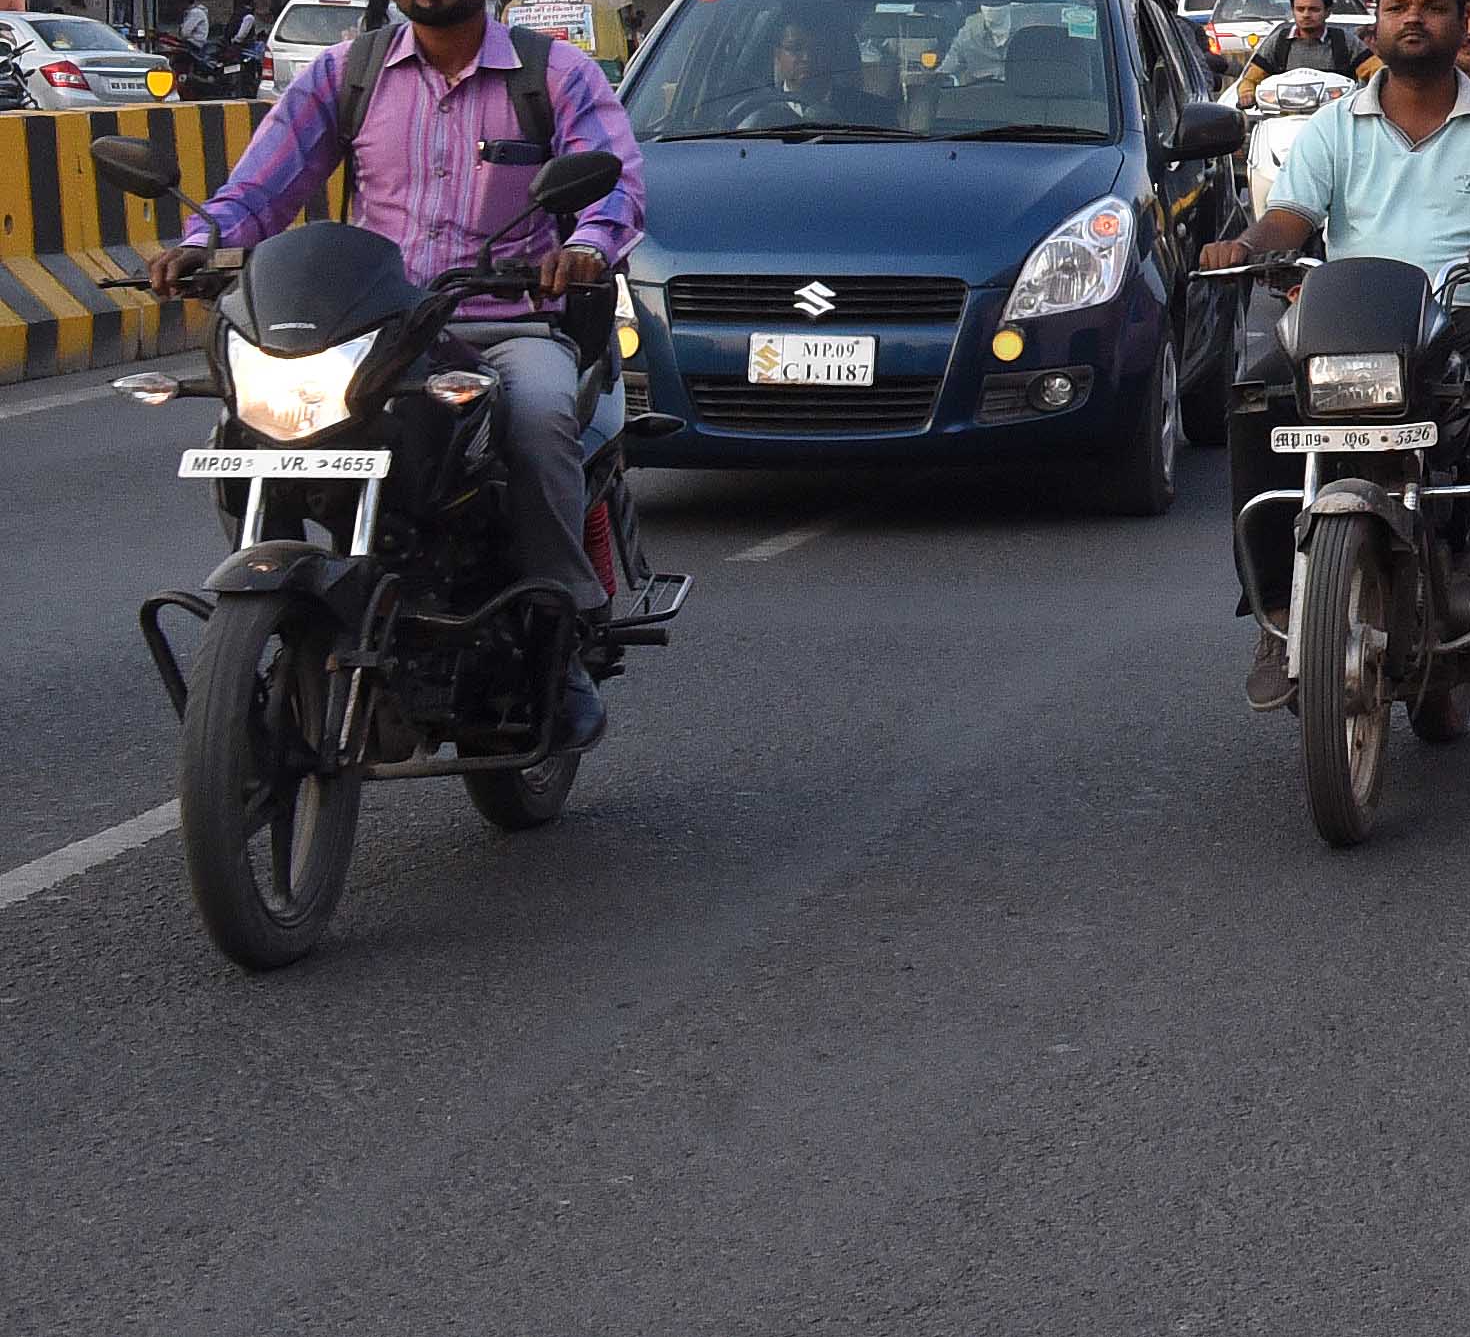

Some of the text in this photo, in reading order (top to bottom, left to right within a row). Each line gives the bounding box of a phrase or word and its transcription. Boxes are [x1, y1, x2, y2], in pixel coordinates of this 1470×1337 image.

[803, 342, 855, 358] MP.09
[192, 456, 242, 471] MP.09
[331, 457, 376, 471] 4655
